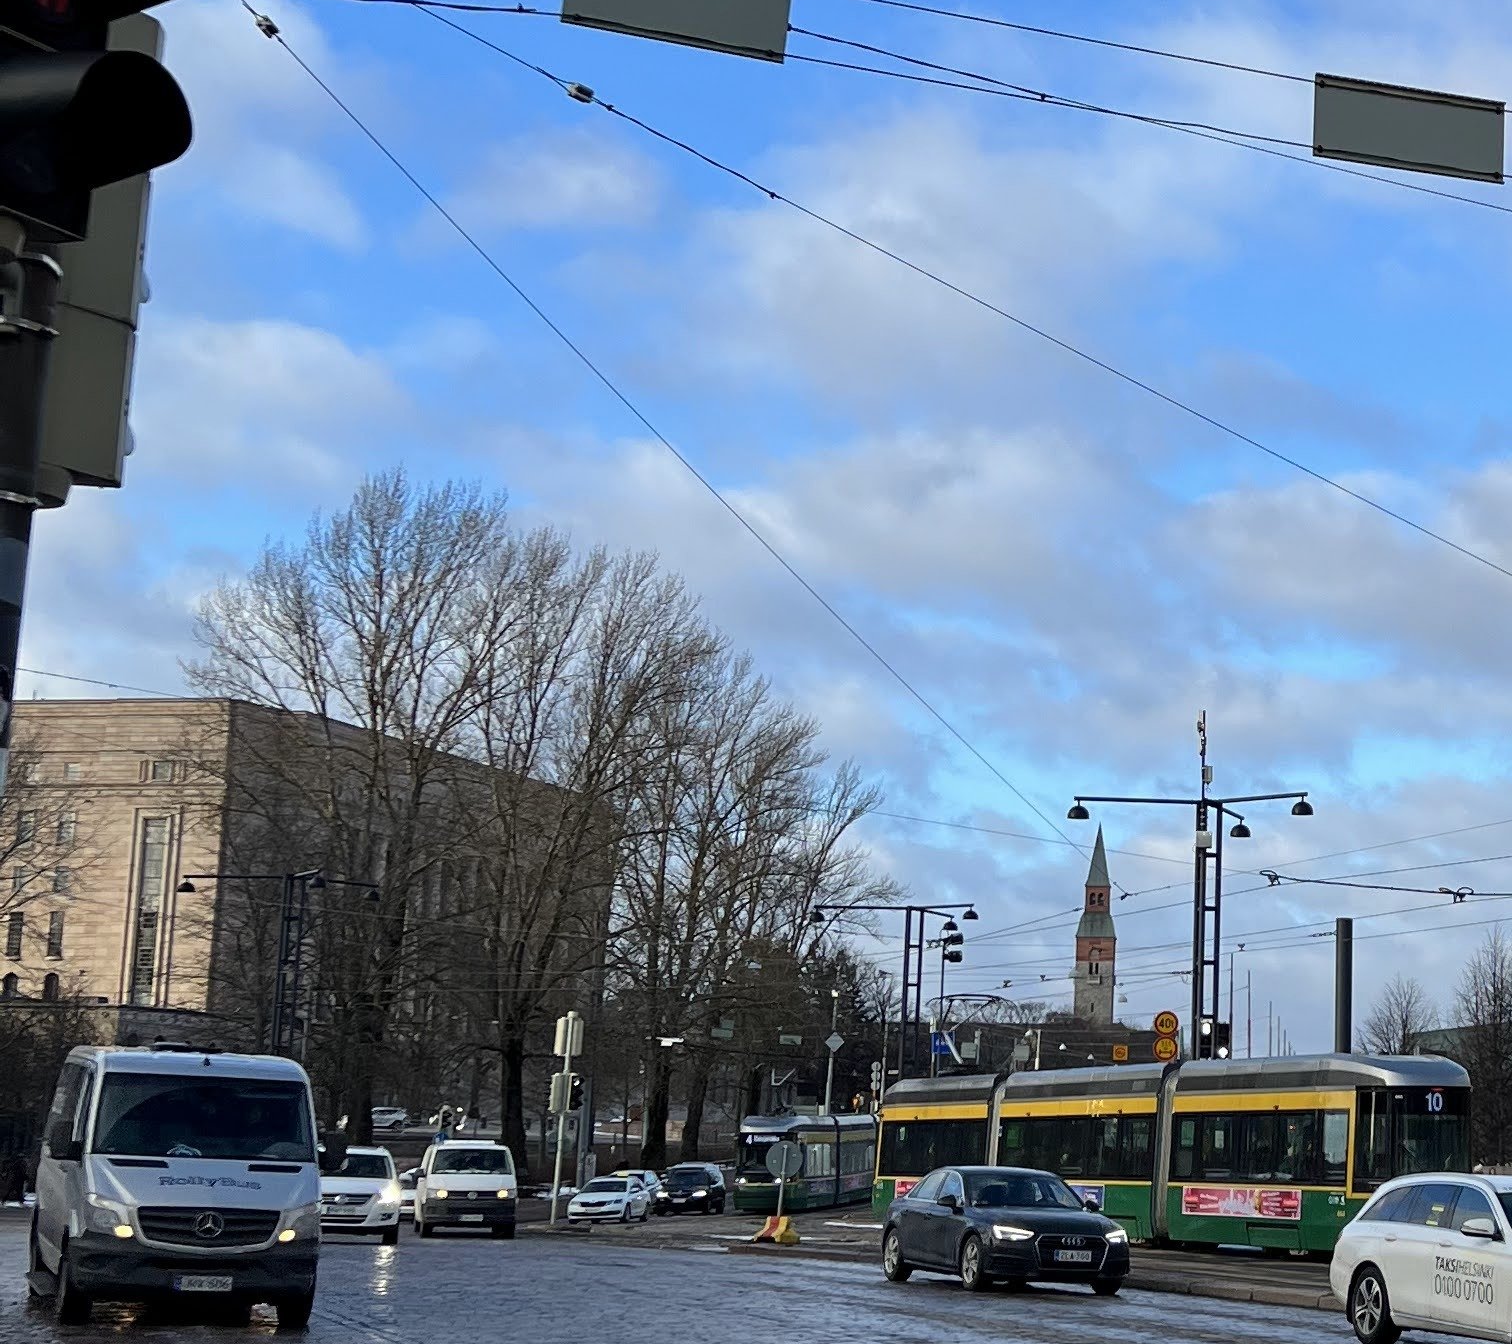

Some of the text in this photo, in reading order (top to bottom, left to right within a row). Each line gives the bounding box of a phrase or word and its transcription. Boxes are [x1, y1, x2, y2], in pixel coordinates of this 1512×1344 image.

[1425, 1091, 1443, 1112] 10
[1434, 1273, 1494, 1305] 0100 0700
